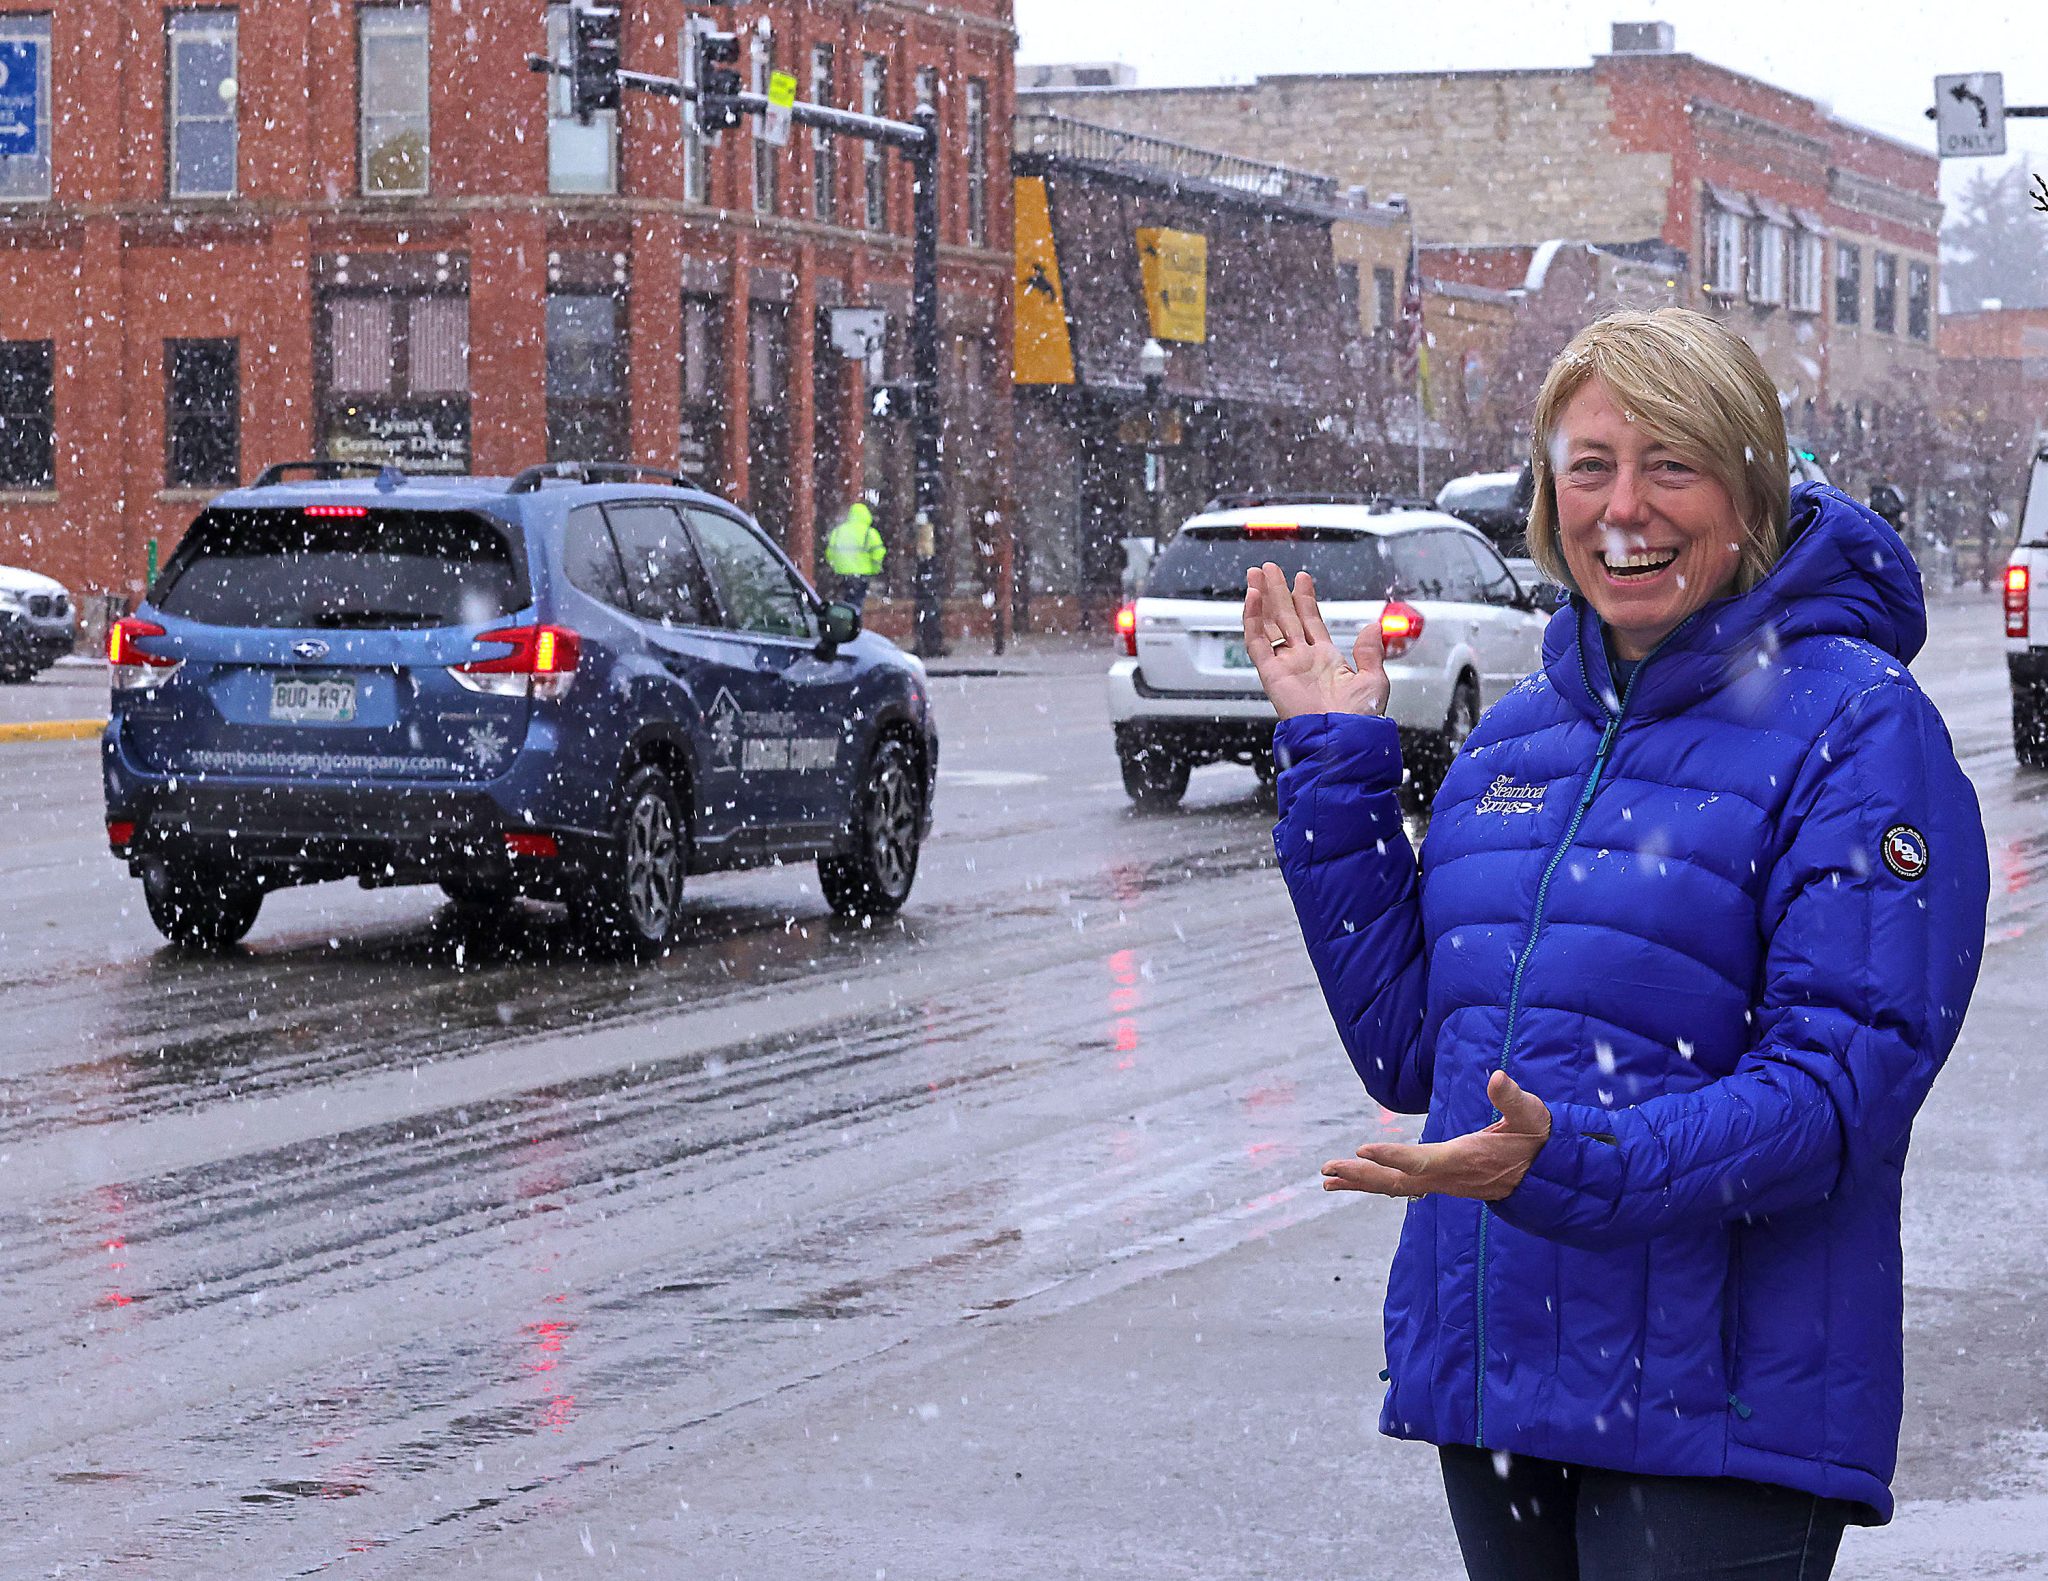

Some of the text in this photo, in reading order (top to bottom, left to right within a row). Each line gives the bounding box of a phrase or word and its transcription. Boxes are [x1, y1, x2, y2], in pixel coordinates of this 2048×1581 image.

[1947, 133, 1997, 150] ONLY
[335, 436, 405, 451] Corner
[1486, 782, 1547, 798] Steamboat
[1475, 796, 1521, 816] Springs
